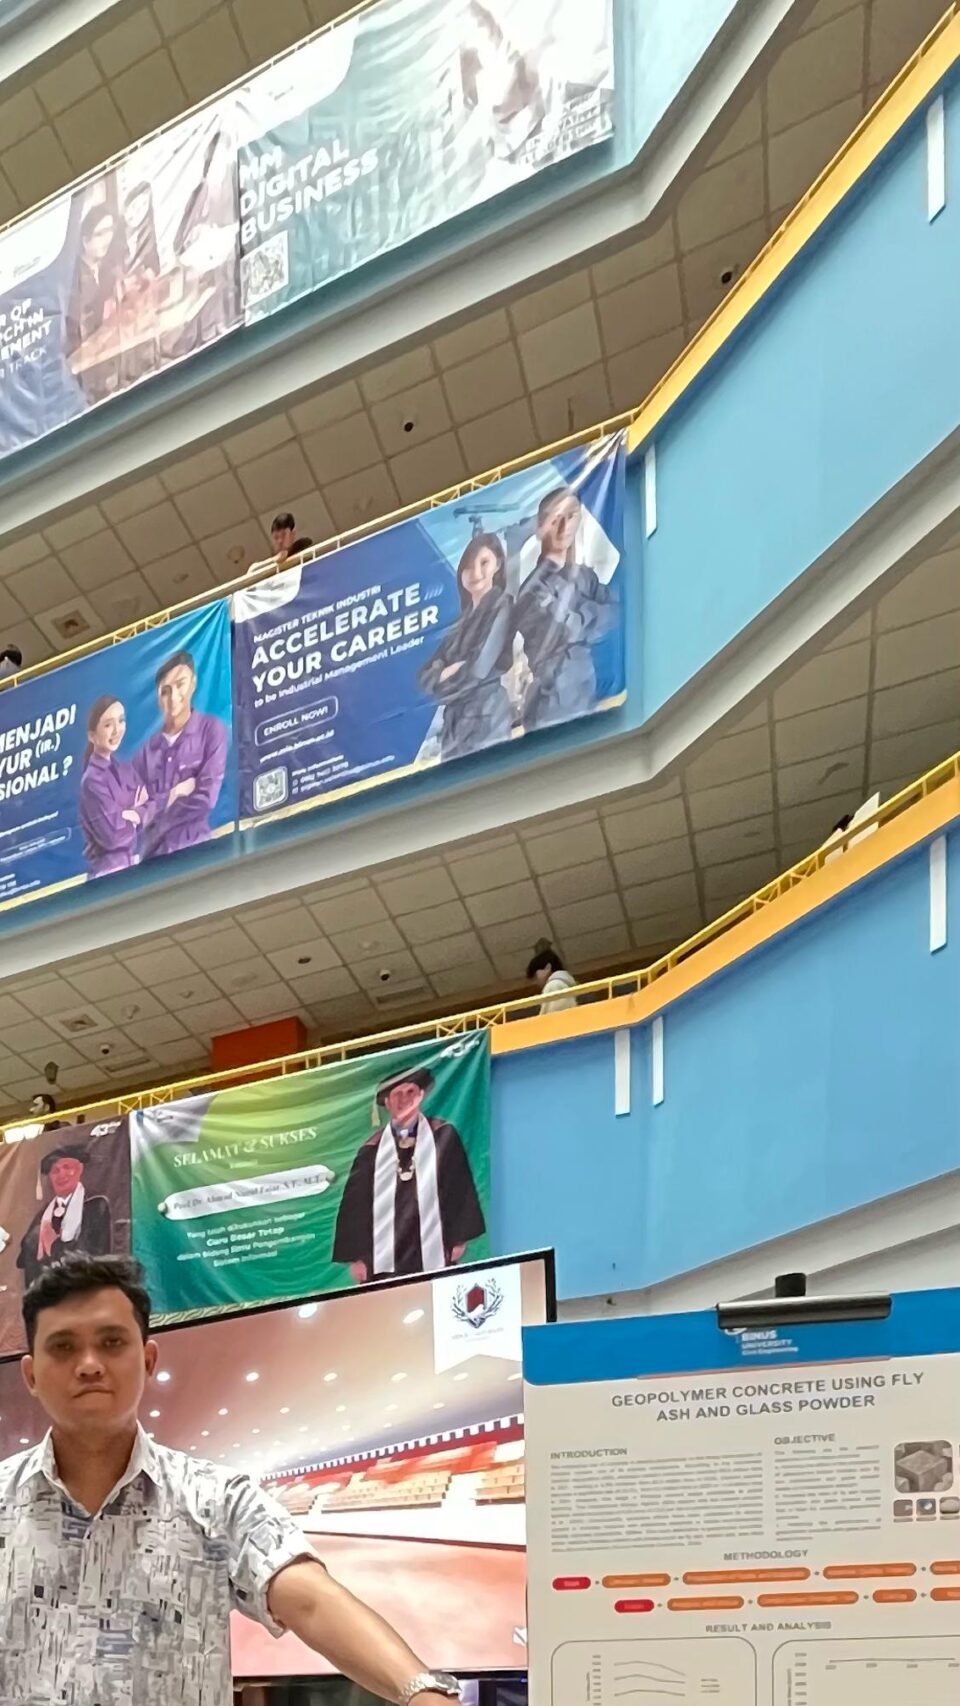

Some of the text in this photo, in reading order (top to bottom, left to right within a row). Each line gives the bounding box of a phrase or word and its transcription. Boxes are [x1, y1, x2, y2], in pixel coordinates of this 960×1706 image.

[240, 145, 282, 188] MM
[240, 139, 350, 217] DIGITAL
[241, 148, 379, 245] BUSINESS
[11, 297, 32, 321] OF
[251, 582, 421, 670] ACCELERATE
[254, 618, 300, 644] MAGISTER
[336, 584, 382, 611] INDUSTRI
[251, 604, 440, 694] YOUR CAREER
[611, 1371, 924, 1409] GEOPOLYMER CONCRETE USING FLY
[656, 1393, 876, 1422] ASH AND GLASS POWDER
[550, 1447, 628, 1460] INTRODUCTION
[773, 1433, 836, 1446] OBJECTIVE
[723, 1549, 809, 1562] METHODOLOGY
[705, 1621, 832, 1634] RESULT AND ANALYSIS
